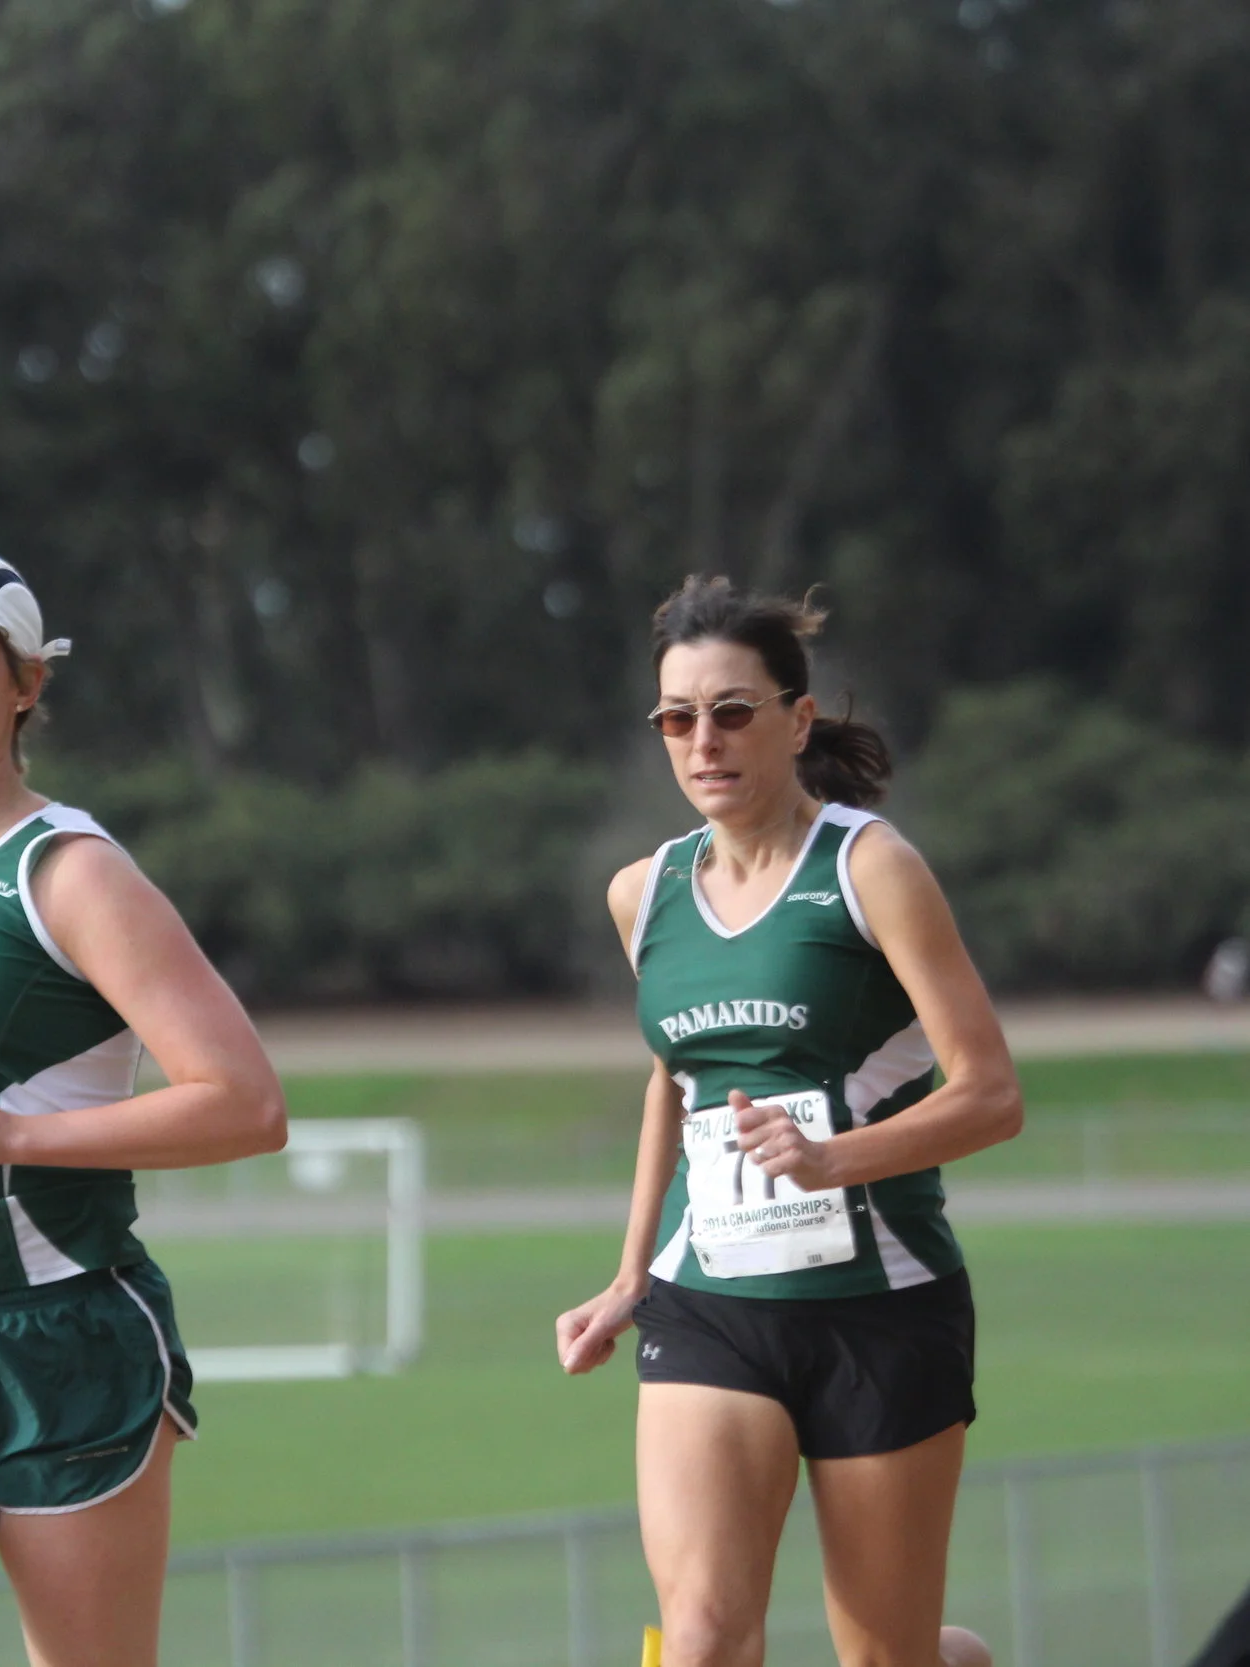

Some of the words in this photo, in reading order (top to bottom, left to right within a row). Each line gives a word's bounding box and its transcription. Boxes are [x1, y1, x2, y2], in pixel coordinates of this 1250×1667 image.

[786, 891, 829, 902] saucony
[658, 999, 809, 1043] PAMAKIDS
[703, 1215, 728, 1232] 2014
[730, 1198, 832, 1227] CHAMPIONSHIPS
[792, 1215, 825, 1228] Course
